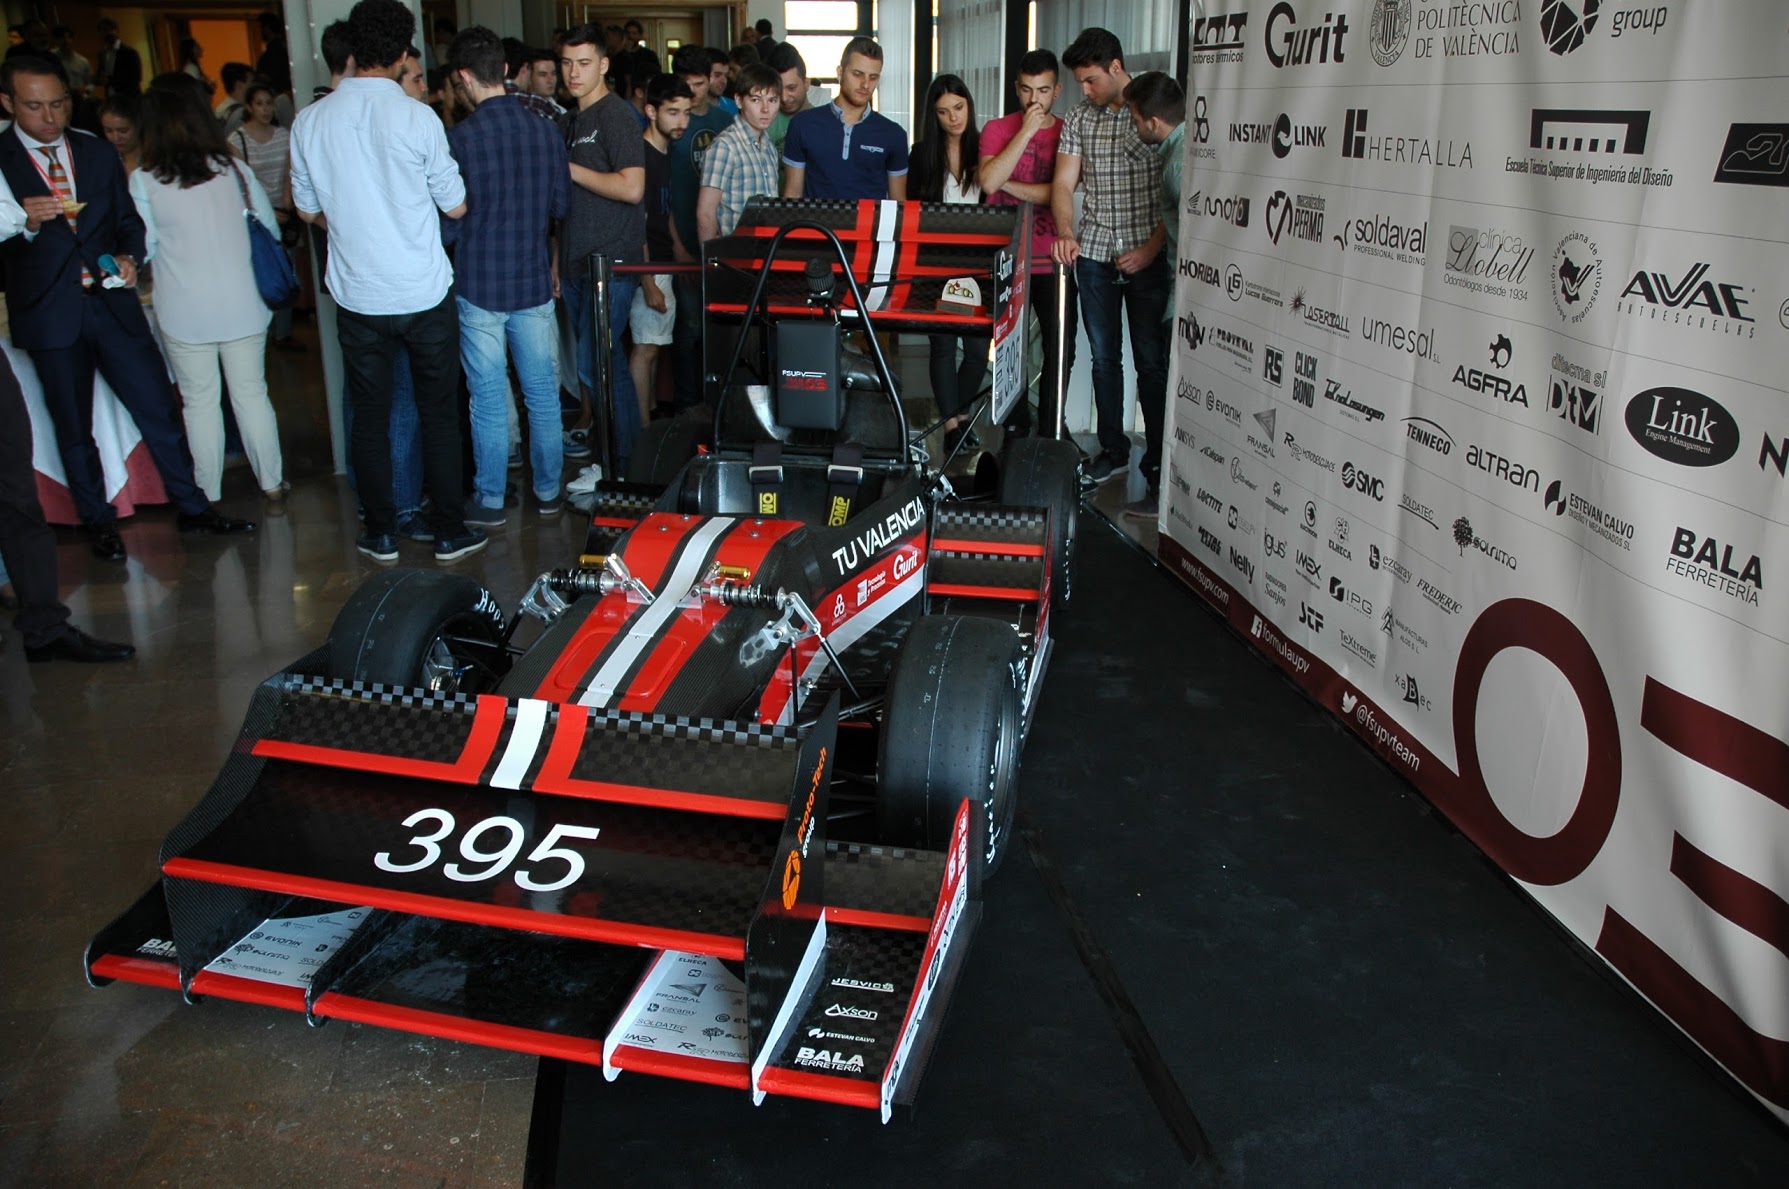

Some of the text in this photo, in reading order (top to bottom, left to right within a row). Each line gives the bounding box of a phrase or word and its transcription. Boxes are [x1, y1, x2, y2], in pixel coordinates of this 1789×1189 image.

[1265, 1, 1349, 68] Gurit
[1611, 7, 1667, 38] group
[1415, 28, 1519, 58] DE VALÈNCIA
[1229, 123, 1328, 147] INSTANT LINK
[1368, 137, 1473, 168] HERTALLA
[1505, 157, 1528, 174] Escuela
[1548, 160, 1575, 180] Superior
[1576, 163, 1585, 179] de
[1586, 165, 1625, 185] Ingeniería
[1628, 167, 1642, 184] del
[1643, 168, 1673, 187] Diseño
[1293, 208, 1324, 243] PERMA
[1355, 214, 1427, 253] soldaval
[1353, 244, 1426, 267] PROFESSIONAL WELDING
[1179, 258, 1221, 288] HORIBA
[1484, 284, 1506, 297] desde
[1509, 288, 1528, 301] 1934
[1362, 316, 1434, 360] umesal
[1264, 349, 1283, 385] RS
[1295, 351, 1318, 381] CLICK
[1293, 377, 1315, 409] BOND
[1452, 365, 1529, 408] AGFRA
[1647, 394, 1718, 444] Link
[1406, 423, 1451, 456] TENNECO
[1645, 428, 1711, 455] Engine Management
[1356, 470, 1384, 502] SMC
[1401, 494, 1434, 520] SOLDATEC
[1569, 493, 1635, 540] ESTEVAN CALVO
[832, 496, 925, 575] TU VALENCIA
[893, 550, 919, 580] Gurit
[1229, 546, 1255, 584] Nelly
[1383, 556, 1412, 583] ezcaray
[1670, 526, 1762, 590] BALA
[1417, 578, 1462, 614] FREDERIC
[1666, 557, 1759, 607] FERRETERÍA
[1346, 589, 1373, 615] IPG
[1262, 622, 1310, 673] formulaupv
[1356, 704, 1420, 771] @fsupvteam
[373, 808, 600, 892] 395
[264, 935, 302, 948] EVONIK
[825, 1003, 878, 1020] Axson
[826, 1031, 876, 1043] ESTEVAN CALVO
[794, 1058, 862, 1073] FERRETERÍA
[797, 1047, 864, 1067] BALA
